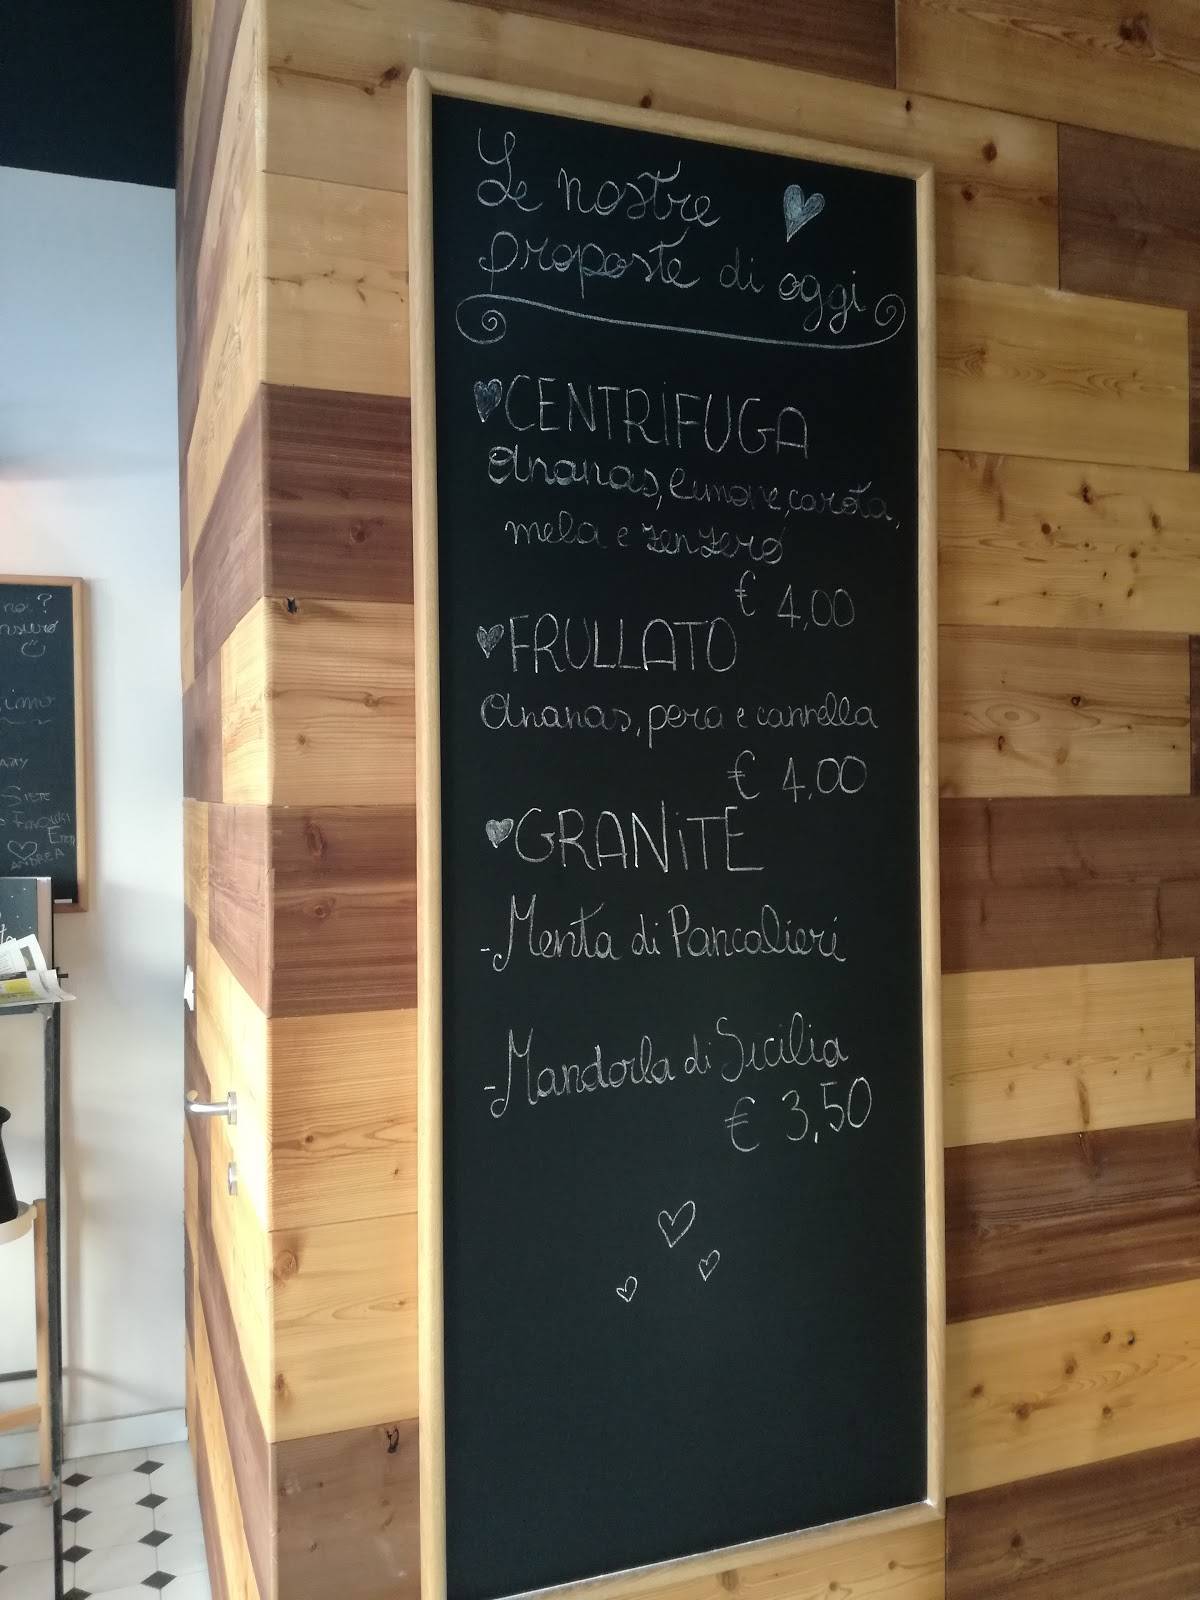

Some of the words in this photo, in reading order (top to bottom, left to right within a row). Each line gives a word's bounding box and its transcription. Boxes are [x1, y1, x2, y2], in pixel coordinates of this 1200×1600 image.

[477, 127, 543, 212] Le
[558, 161, 721, 227] nostre
[479, 227, 700, 299] proposte
[719, 247, 765, 293] di
[778, 270, 867, 335] oggi
[504, 511, 602, 545] mela
[617, 526, 631, 548] e
[734, 570, 756, 618] €
[777, 584, 856, 631] 4,00
[509, 613, 738, 674] FRULLATO
[648, 703, 723, 749] pera
[737, 706, 749, 730] e
[756, 691, 880, 730] cannella
[727, 750, 761, 800] €
[782, 756, 868, 803] 4,00
[631, 914, 661, 957] di
[685, 1034, 712, 1076] di
[716, 1012, 849, 1084] Sicilia
[724, 1096, 761, 1153] €
[782, 1076, 873, 1144] 3,50
